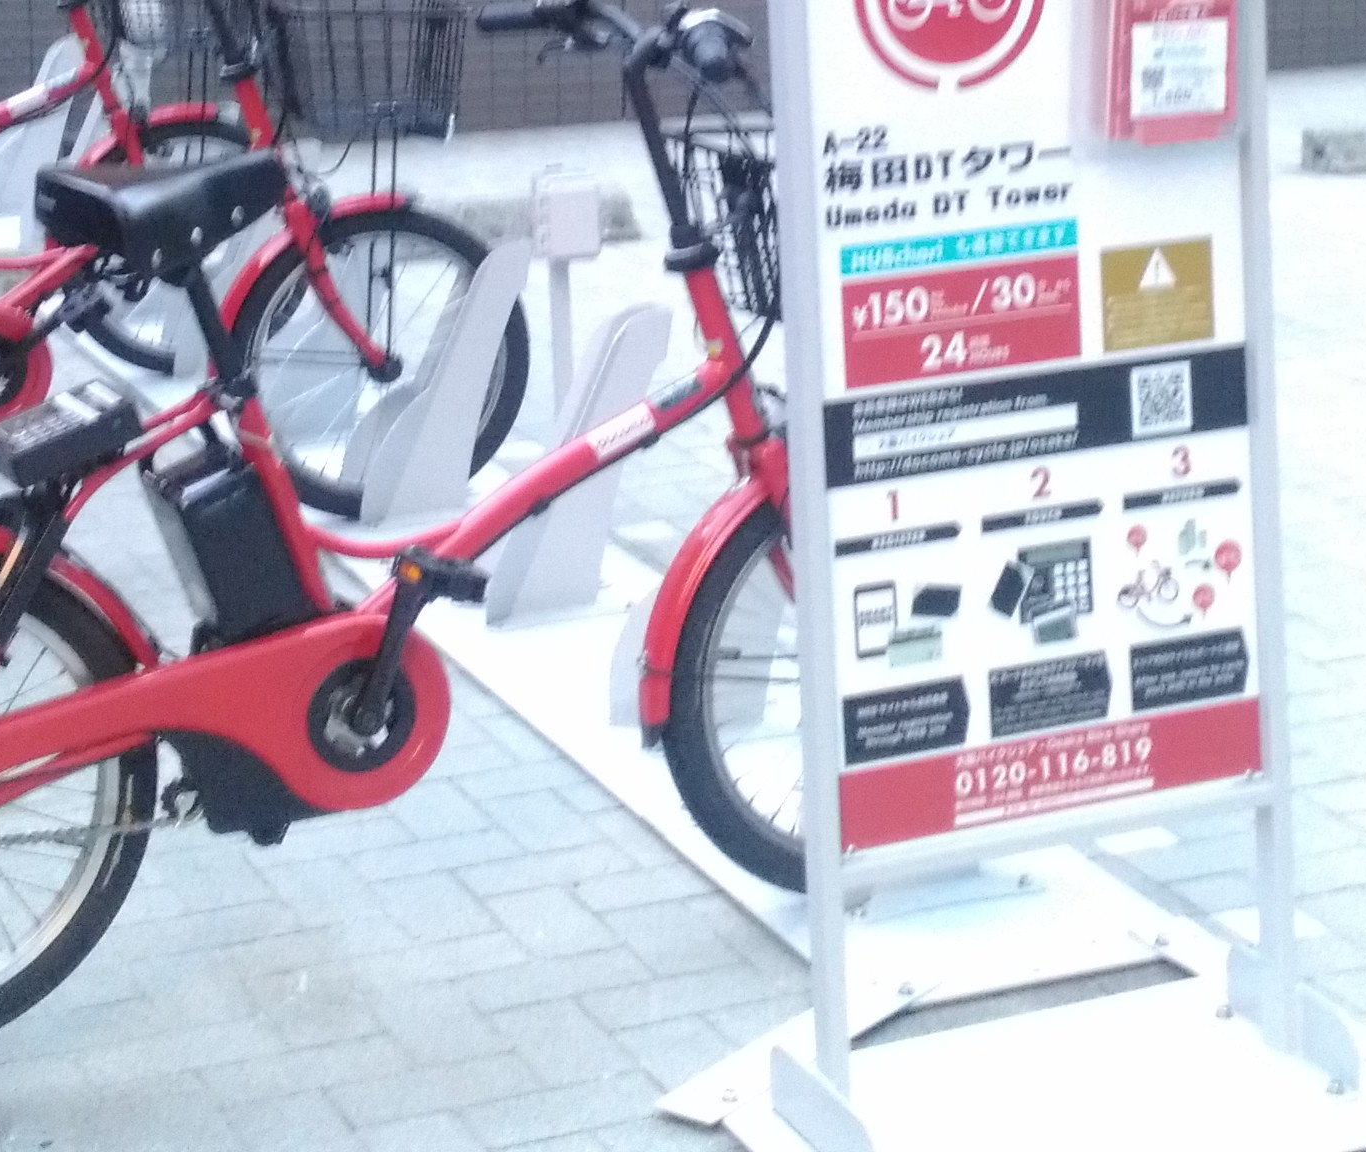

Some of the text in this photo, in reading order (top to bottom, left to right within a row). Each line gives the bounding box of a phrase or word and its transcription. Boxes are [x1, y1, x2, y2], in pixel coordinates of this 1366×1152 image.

[825, 140, 1072, 195] 梅田DTタワー
[825, 182, 1073, 230] Umeda DT Tower
[990, 272, 1037, 313] 30
[921, 330, 967, 373] 24
[887, 445, 1192, 521] 1 2 3
[955, 735, 1153, 797] 0120-116-819
